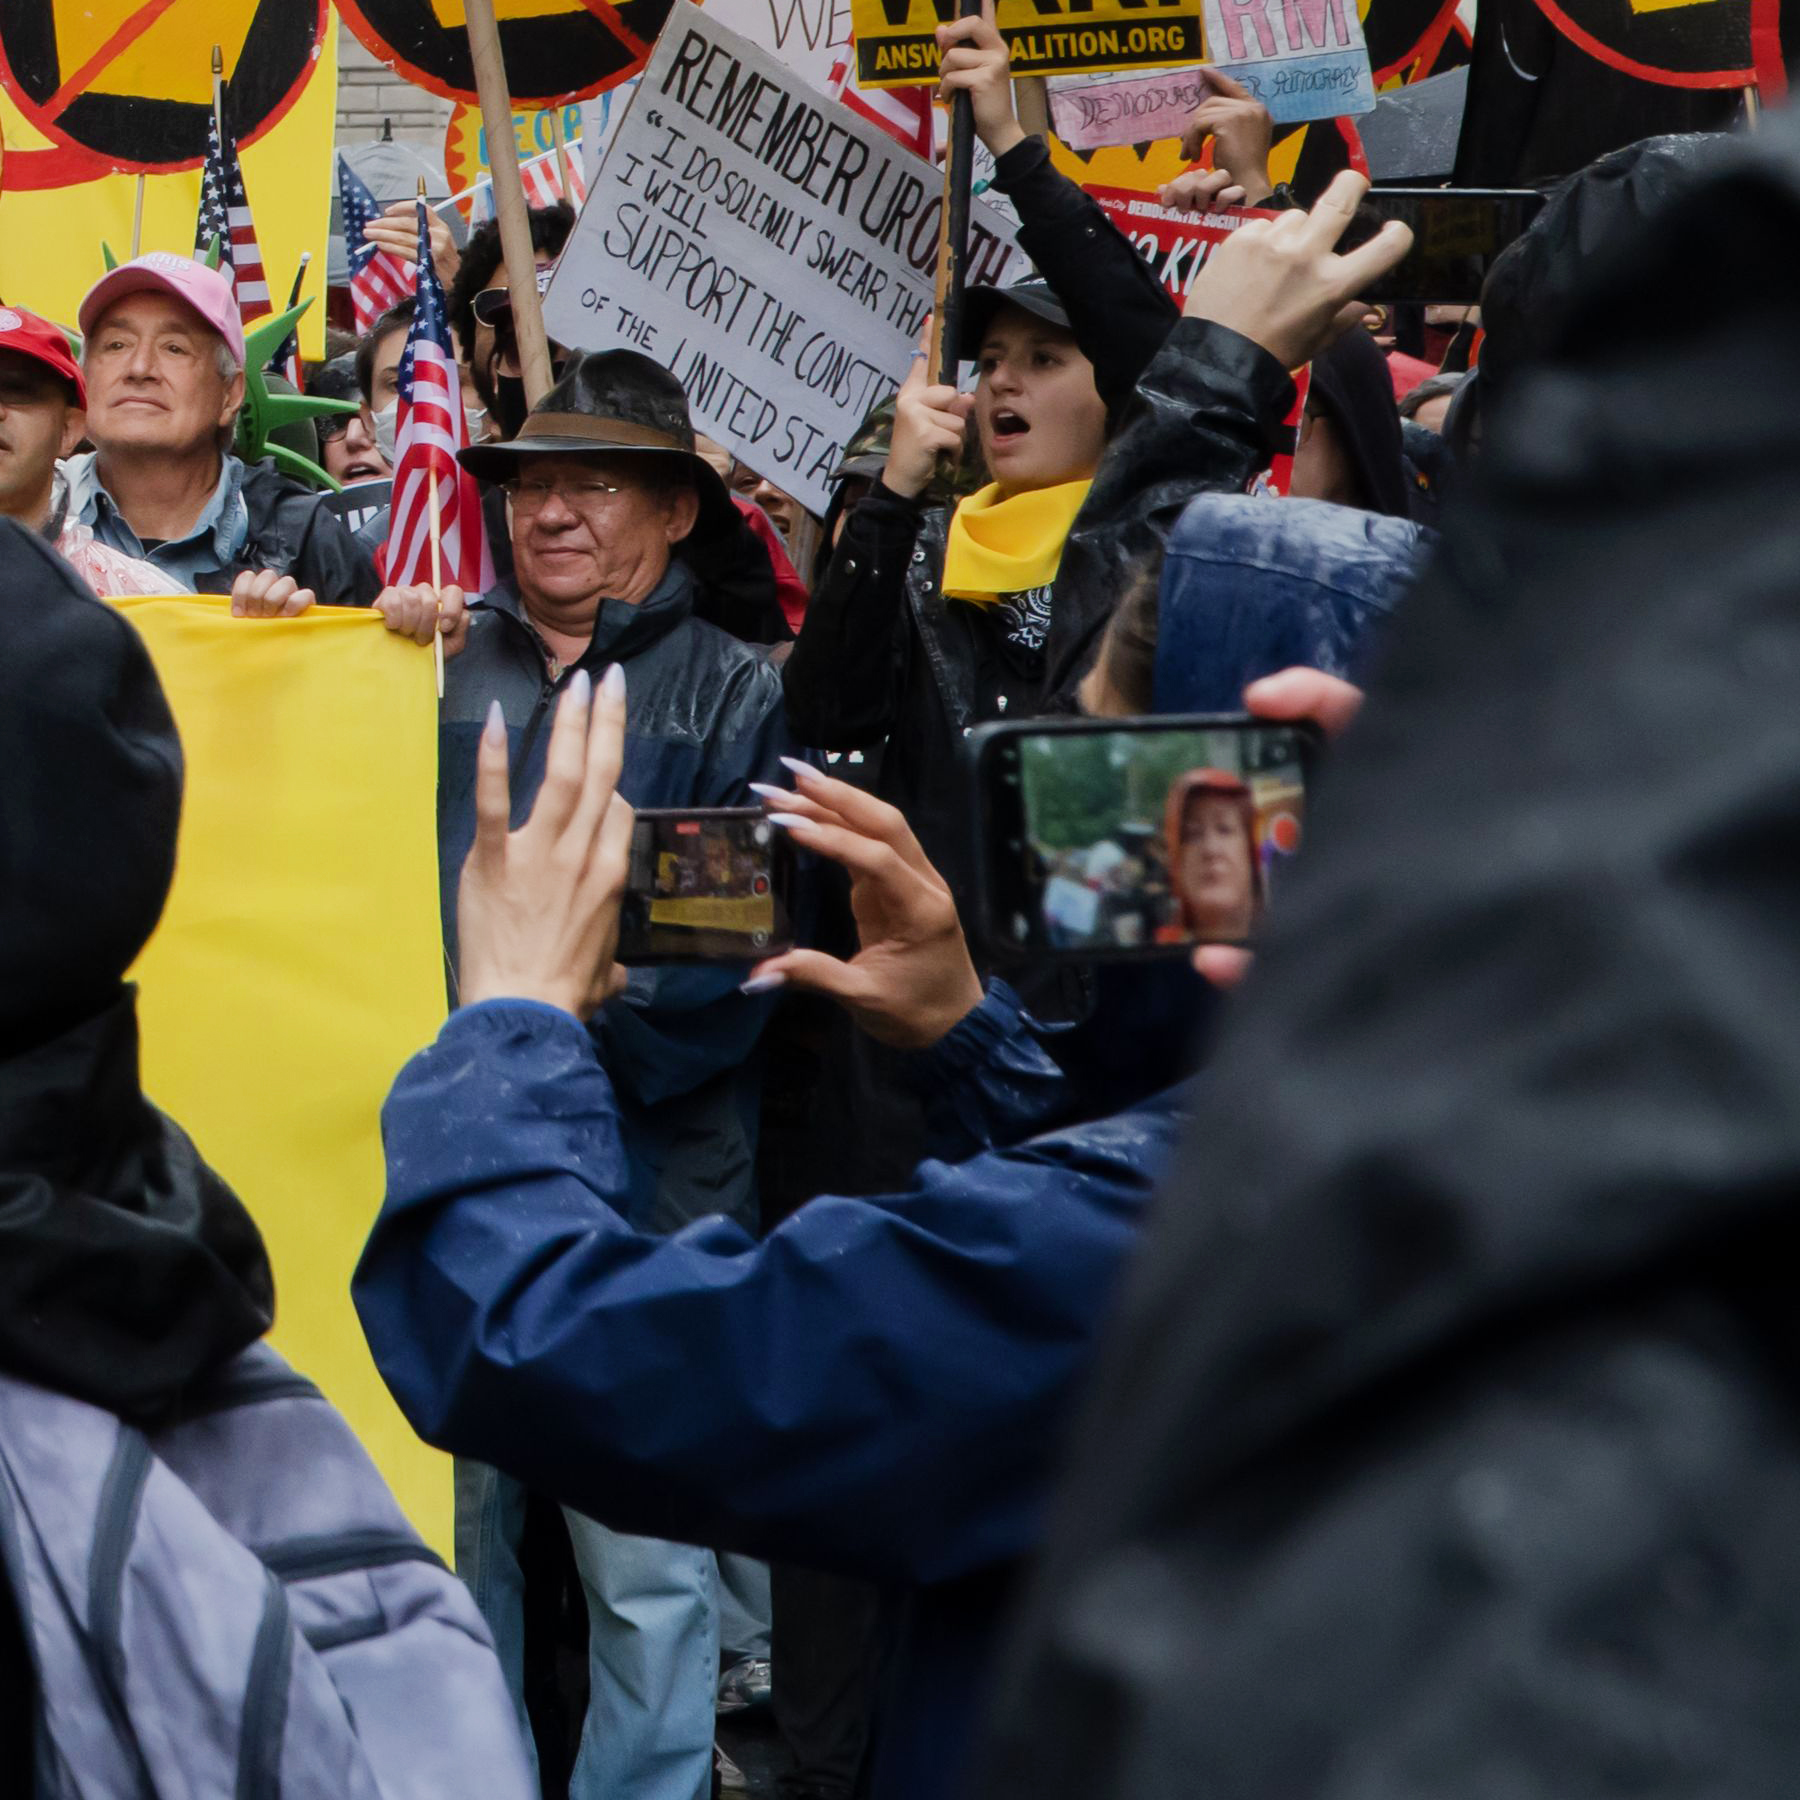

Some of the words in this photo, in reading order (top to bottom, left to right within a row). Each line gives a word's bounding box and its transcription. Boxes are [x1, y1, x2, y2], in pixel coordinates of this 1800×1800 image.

[616, 152, 646, 186] I
[643, 179, 710, 239] WILL
[661, 29, 870, 215] REMEMBER
[604, 201, 757, 335] SUPPORT
[757, 289, 806, 367] THE
[684, 146, 722, 192] DO
[716, 170, 812, 256] SOLEMLY
[808, 228, 886, 311] SWEAR
[581, 288, 611, 313] OF
[616, 306, 659, 351] THE
[668, 339, 779, 444] UNITED
